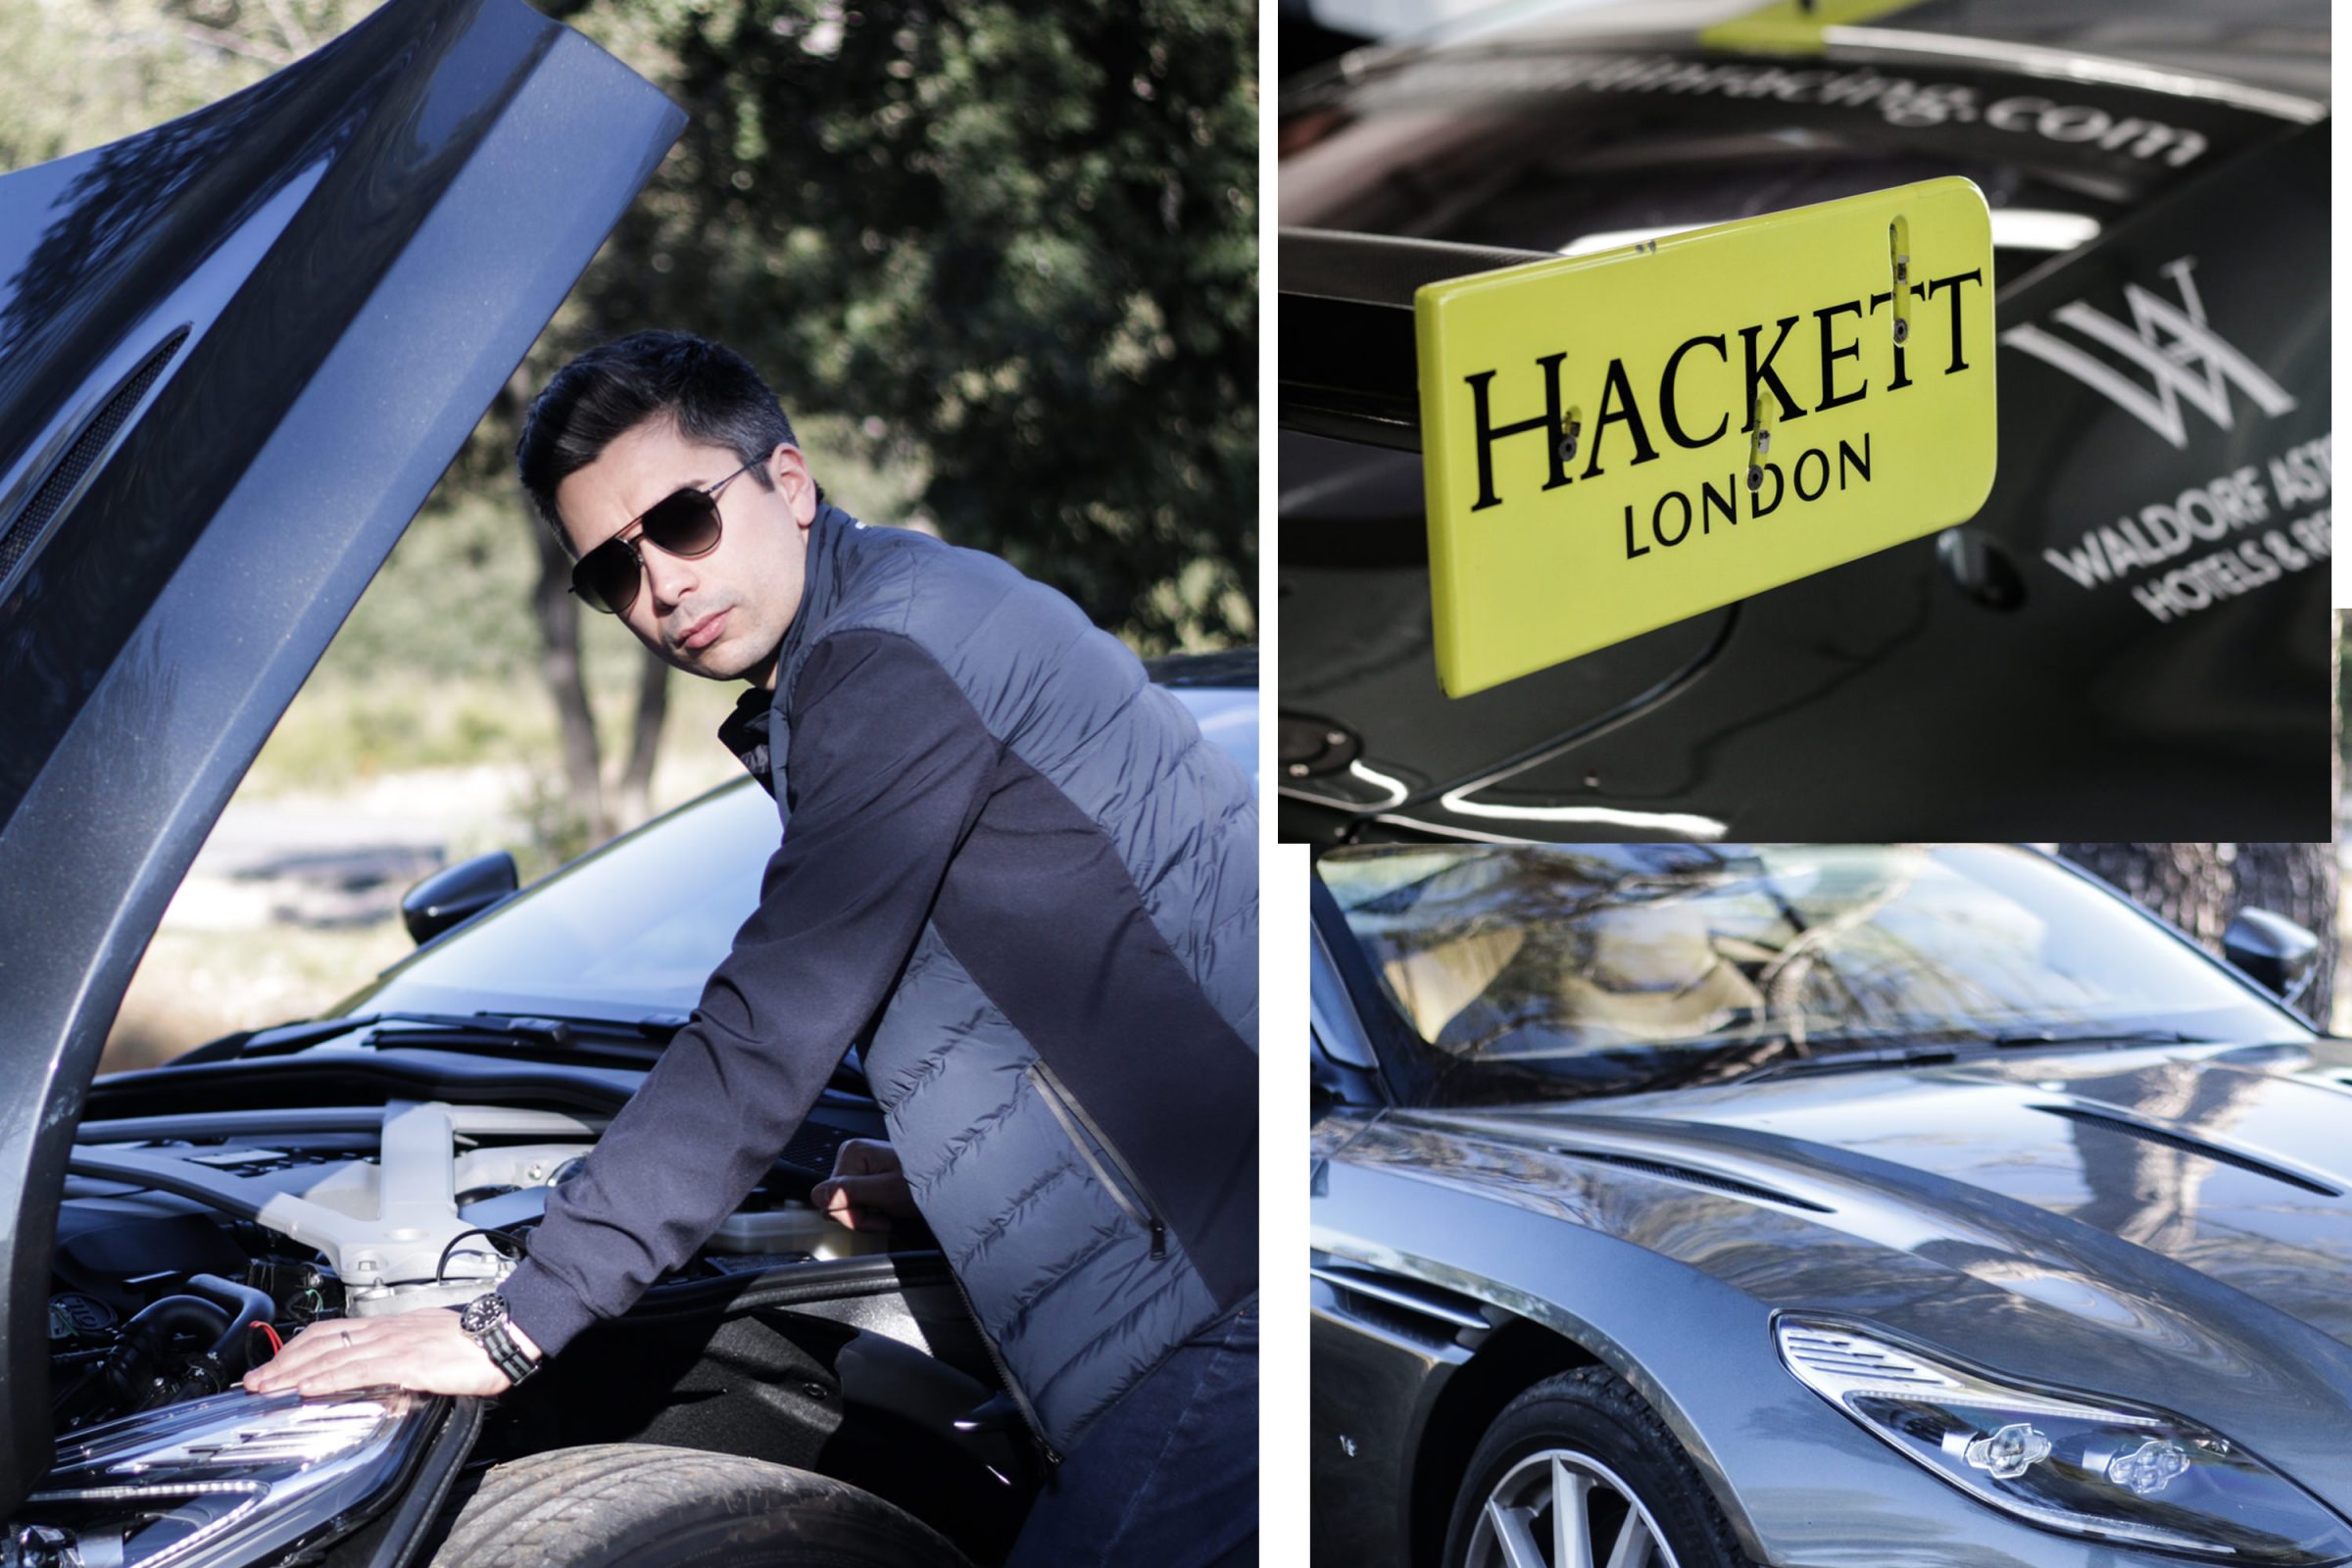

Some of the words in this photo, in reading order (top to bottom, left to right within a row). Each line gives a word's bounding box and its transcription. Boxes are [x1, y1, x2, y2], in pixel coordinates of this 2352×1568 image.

[1464, 269, 1983, 513] HACKETT
[1624, 432, 1872, 561] LONDON
[2042, 466, 2270, 590] WALDORF
[2132, 539, 2283, 623] HOTELS
